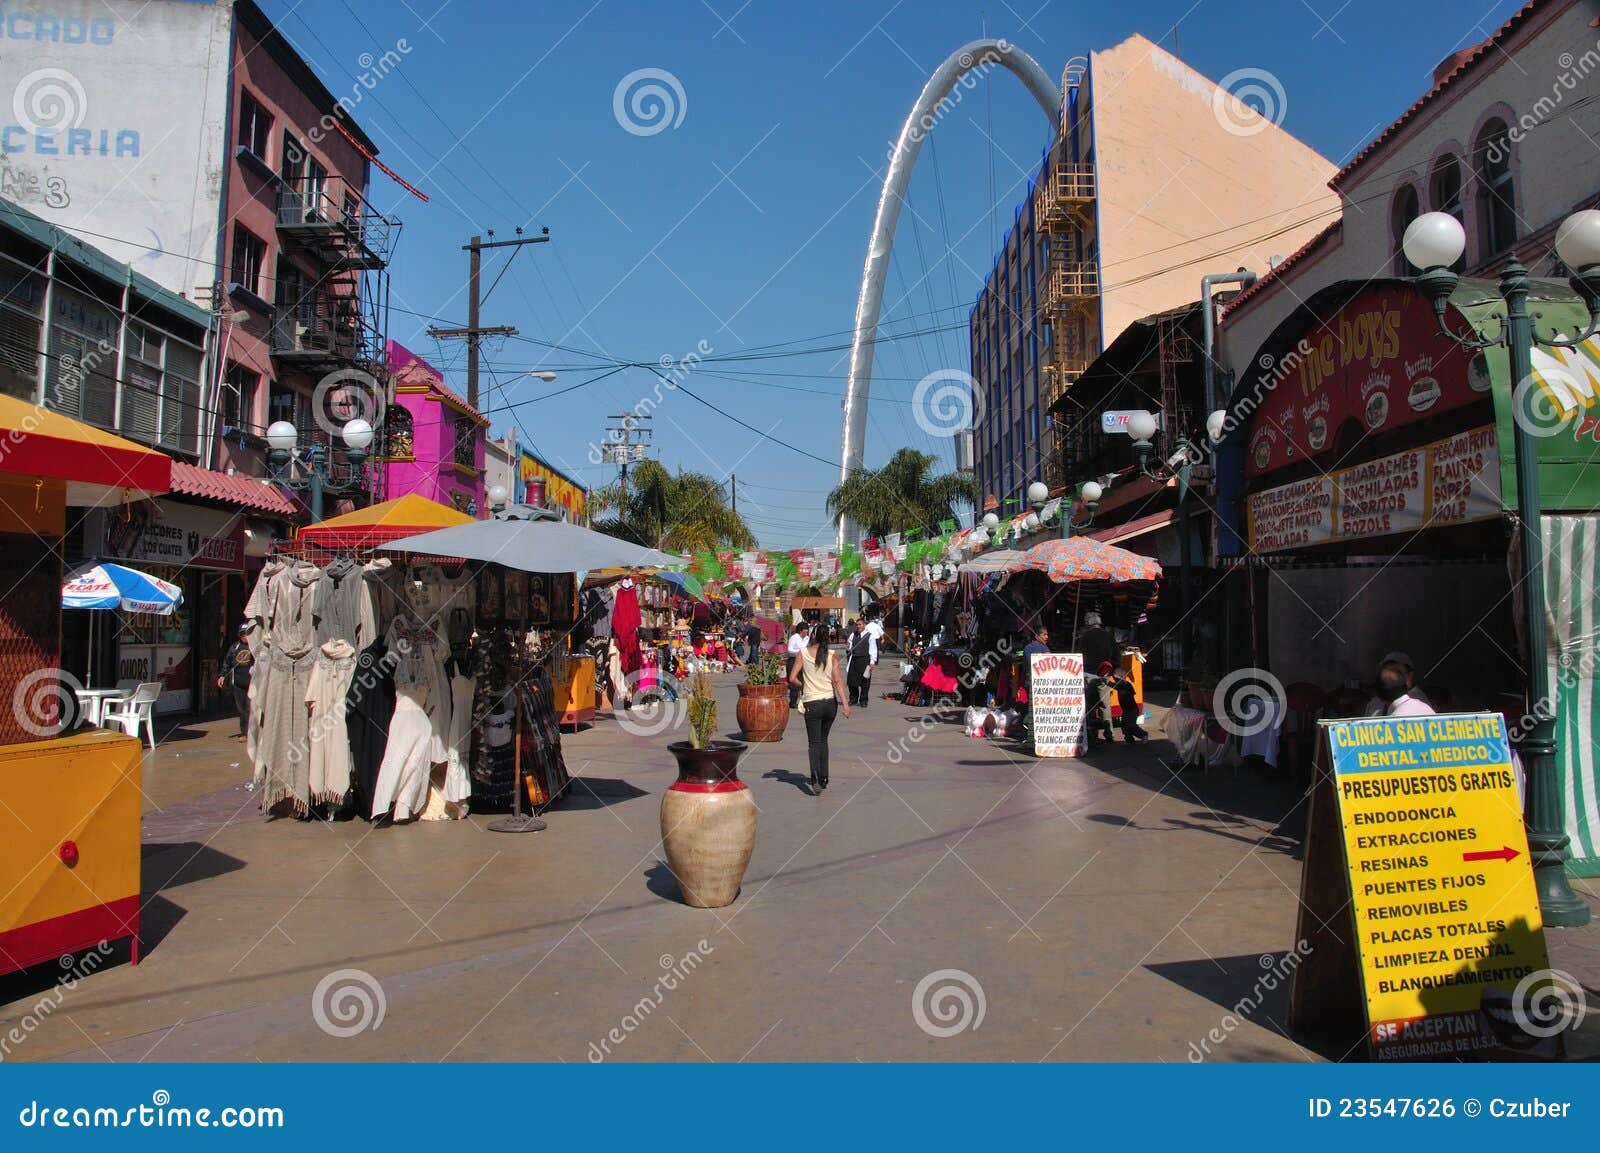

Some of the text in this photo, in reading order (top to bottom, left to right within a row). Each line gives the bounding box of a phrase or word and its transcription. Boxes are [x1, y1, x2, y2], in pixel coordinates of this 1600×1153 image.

[0, 11, 114, 45] CADO
[2, 125, 141, 158] CERIA
[44, 176, 71, 209] 3
[1344, 453, 1418, 486] HUARACHES
[1433, 453, 1483, 481] FLAUTAS
[1344, 471, 1419, 501] ENCHILADAS
[1434, 478, 1471, 503] SOPES
[1342, 493, 1407, 519] BURRITOS
[1433, 500, 1467, 522] MOLE
[1343, 514, 1391, 536] POZOLE
[1034, 687, 1064, 696] PASAPORTE
[1035, 707, 1072, 715] RENOVACION
[1035, 716, 1079, 725] AMPLIFICACION
[1035, 725, 1078, 734] FOTOGRAFIAS
[1037, 735, 1063, 744] BLANCO
[1336, 718, 1502, 748] CLINICA SAN CLEMENTE
[1358, 749, 1418, 768] DENTAL
[1431, 746, 1488, 763] MEDICO
[1342, 770, 1512, 800] PRESUPUESTOS GRATIS
[1354, 806, 1457, 826] ENDODONCIA
[1357, 828, 1477, 849] EXTRACCIONES
[1360, 855, 1429, 873] RESINAS
[1364, 873, 1486, 897] PUENTES FIJOS
[1367, 899, 1469, 921] REMOVIBLES
[1371, 920, 1506, 945] PLACAS TOTALES
[1374, 943, 1515, 969] LIMPIEZA DENTAL
[1378, 965, 1534, 994] BLANQUEAMIENTOS
[1376, 1014, 1478, 1042] SE ACEPTAN
[1377, 1041, 1452, 1061] ASEGURANZAS
[1456, 1039, 1470, 1051] DE
